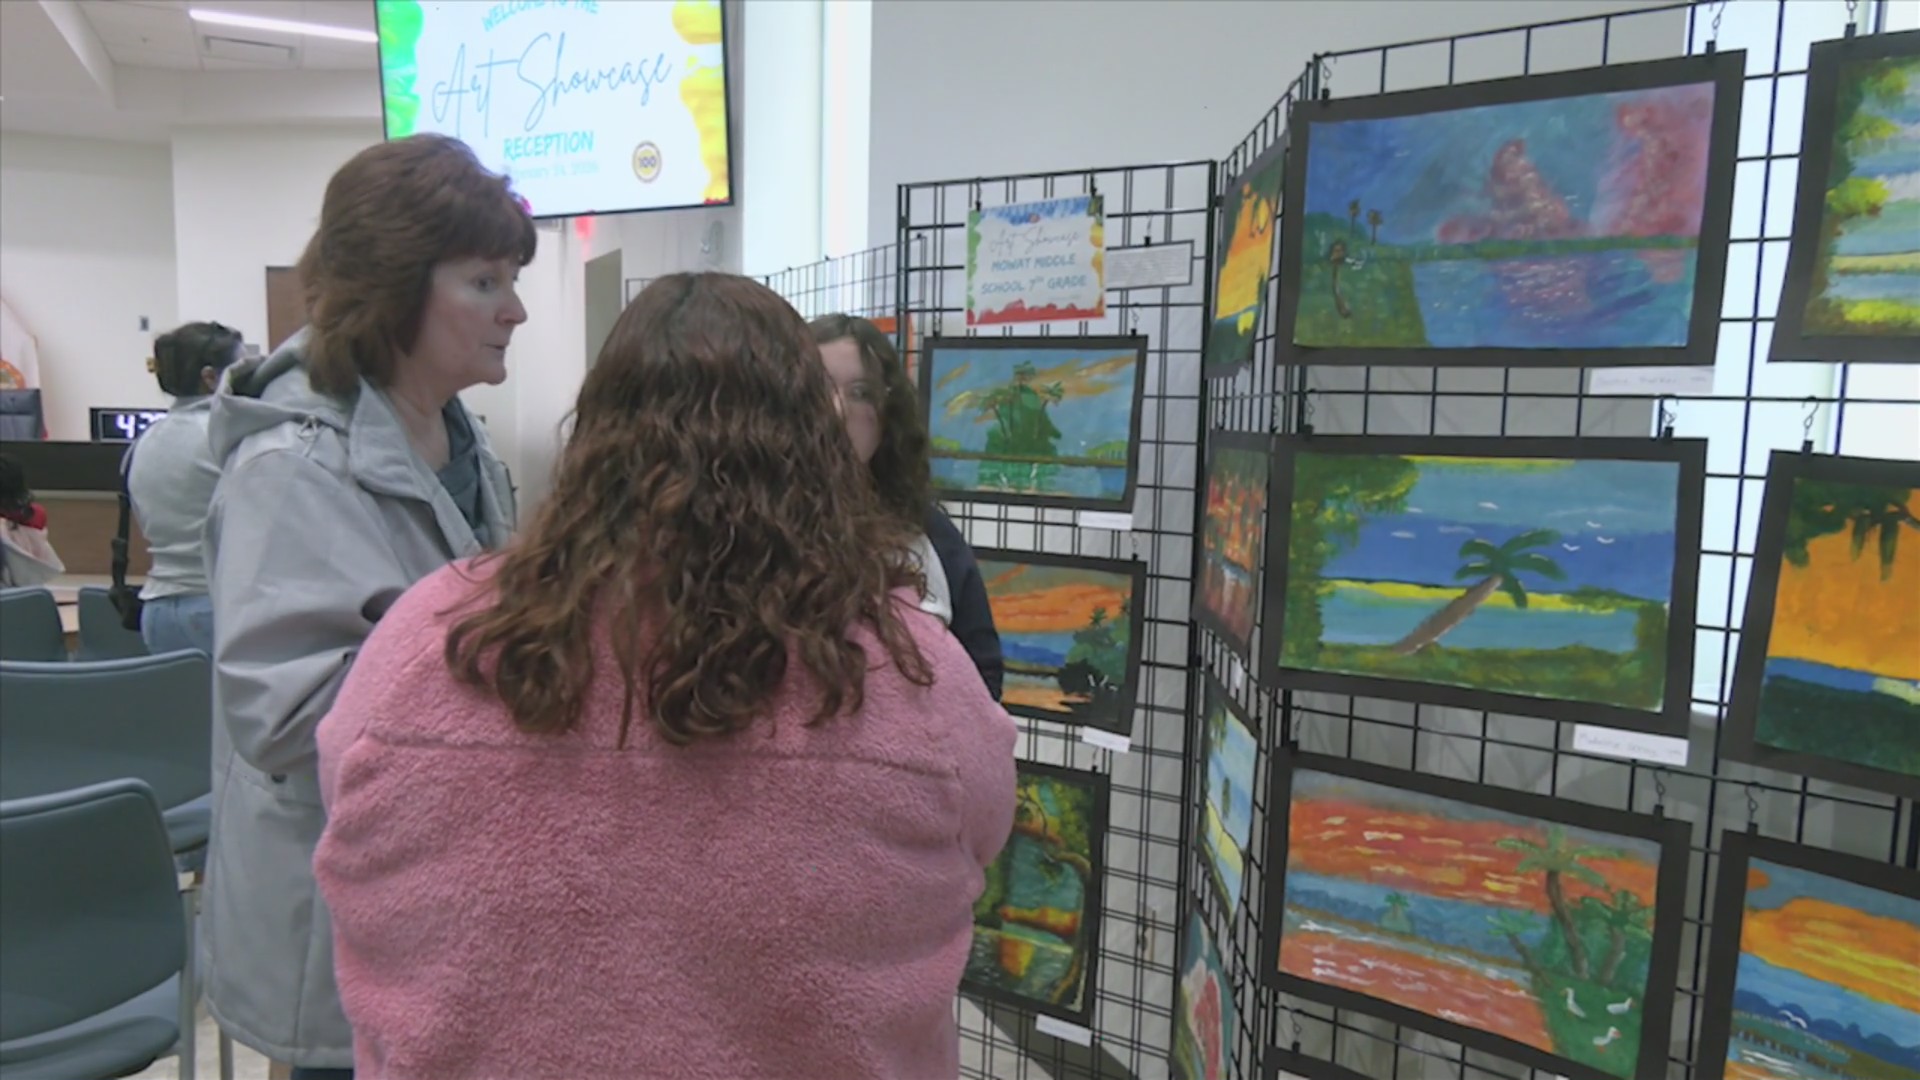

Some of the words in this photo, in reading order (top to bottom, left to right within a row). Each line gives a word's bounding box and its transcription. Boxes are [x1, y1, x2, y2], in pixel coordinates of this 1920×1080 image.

[432, 43, 518, 138] Art
[515, 31, 673, 132] Showcase
[503, 130, 595, 161] RECEPTION
[991, 256, 1032, 272] MOWAT
[1033, 252, 1077, 269] MIDDLE
[981, 280, 1025, 295] SCHOOL
[1046, 274, 1087, 290] GRADE
